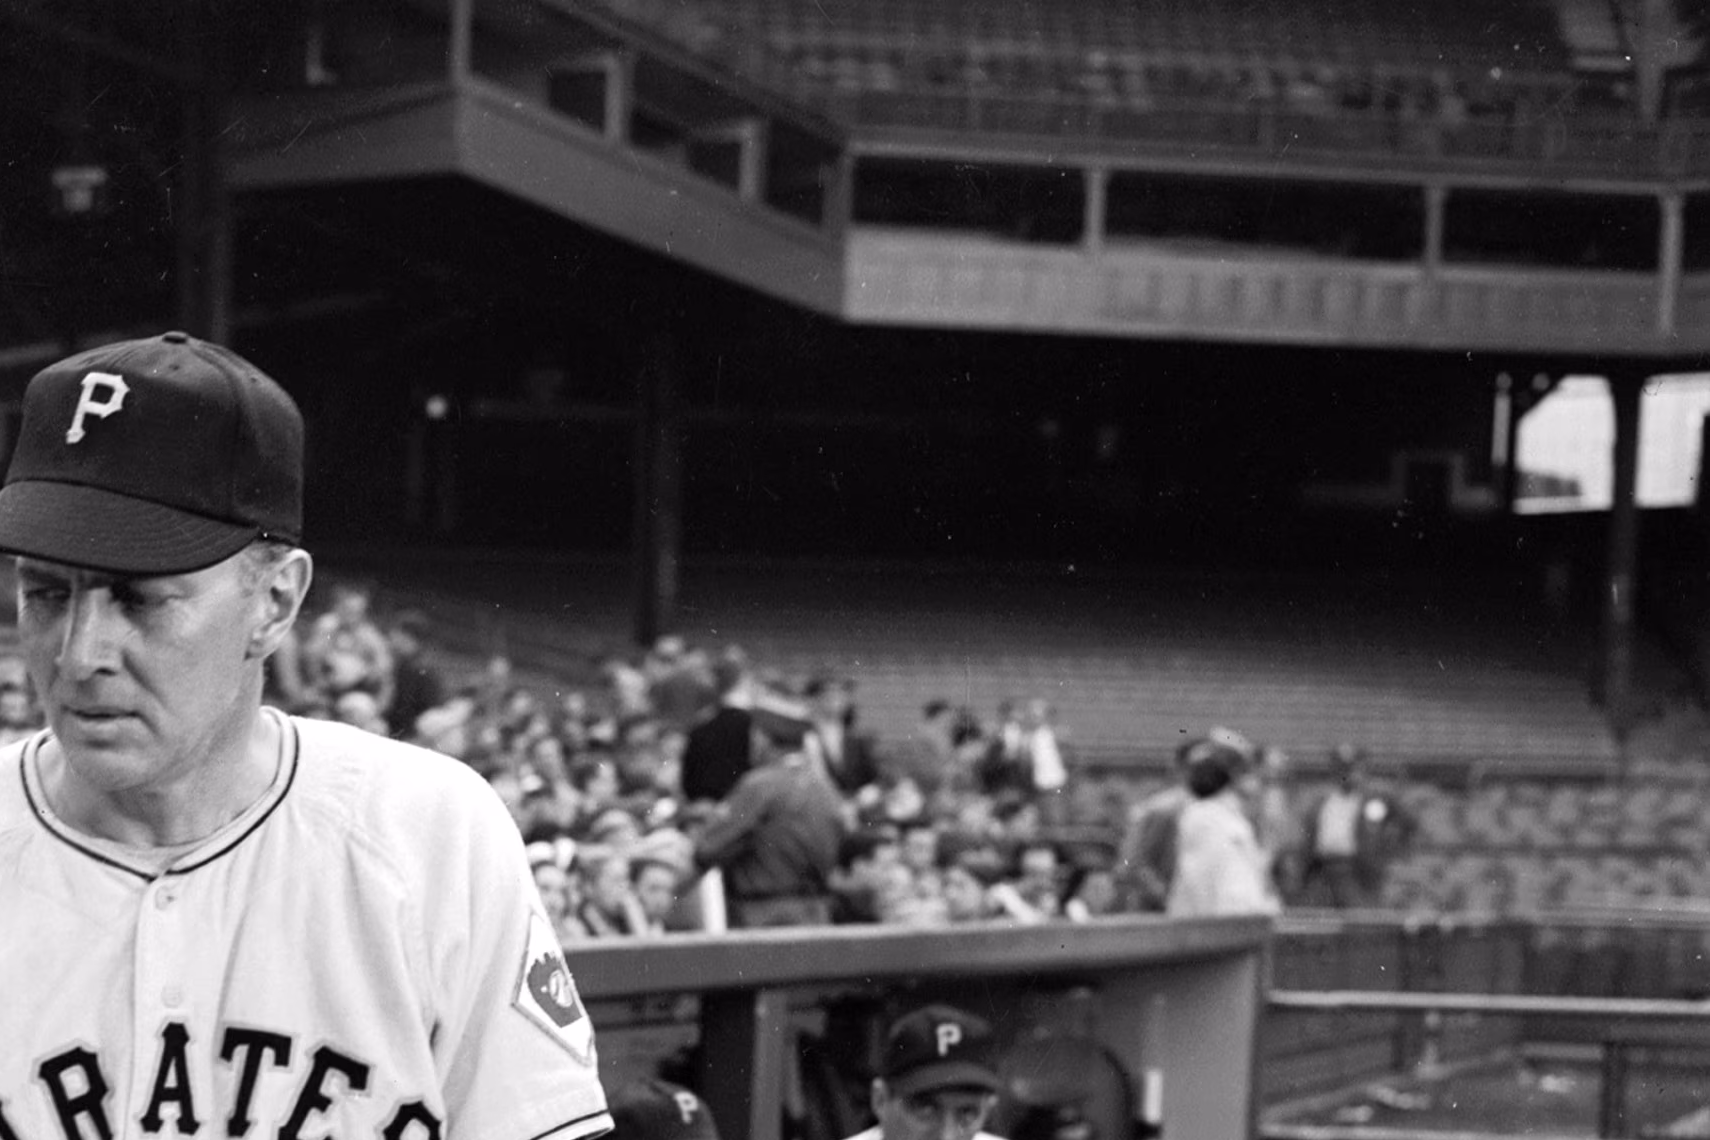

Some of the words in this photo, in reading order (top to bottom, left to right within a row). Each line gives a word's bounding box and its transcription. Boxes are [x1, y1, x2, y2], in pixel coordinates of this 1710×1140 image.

[66, 372, 130, 444] P
[936, 1023, 962, 1057] P
[674, 1091, 699, 1124] P
